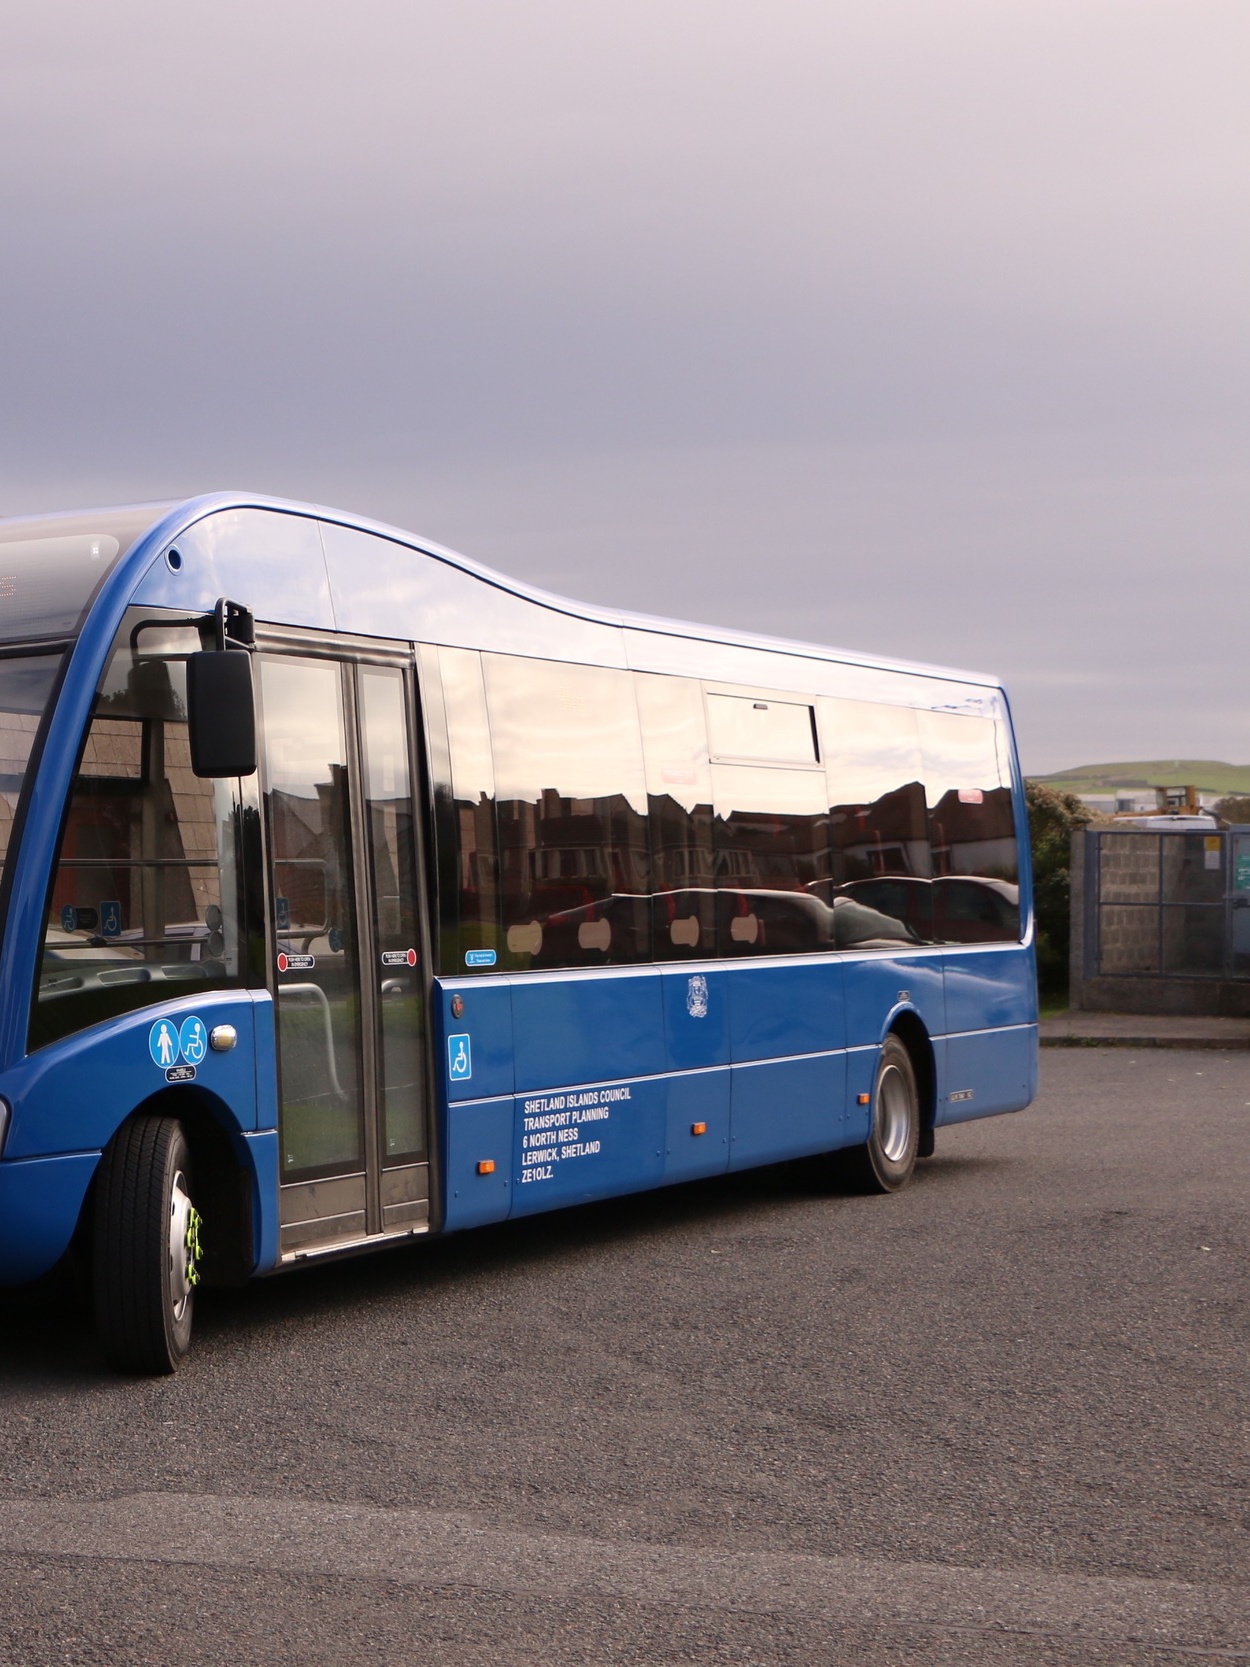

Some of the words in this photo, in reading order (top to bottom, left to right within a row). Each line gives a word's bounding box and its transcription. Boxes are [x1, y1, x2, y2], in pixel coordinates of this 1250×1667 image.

[524, 1096, 566, 1114] SHETLAND
[566, 1091, 599, 1108] ISLANDS
[599, 1087, 632, 1103] COUNCIL
[523, 1112, 571, 1131] TRANSPORT
[571, 1106, 610, 1124] PLANNING
[522, 1135, 528, 1149] 6
[529, 1130, 557, 1148] NORTH
[558, 1127, 579, 1143] NESS
[521, 1147, 560, 1166] LERWICK,
[561, 1140, 601, 1159] SHETLAND
